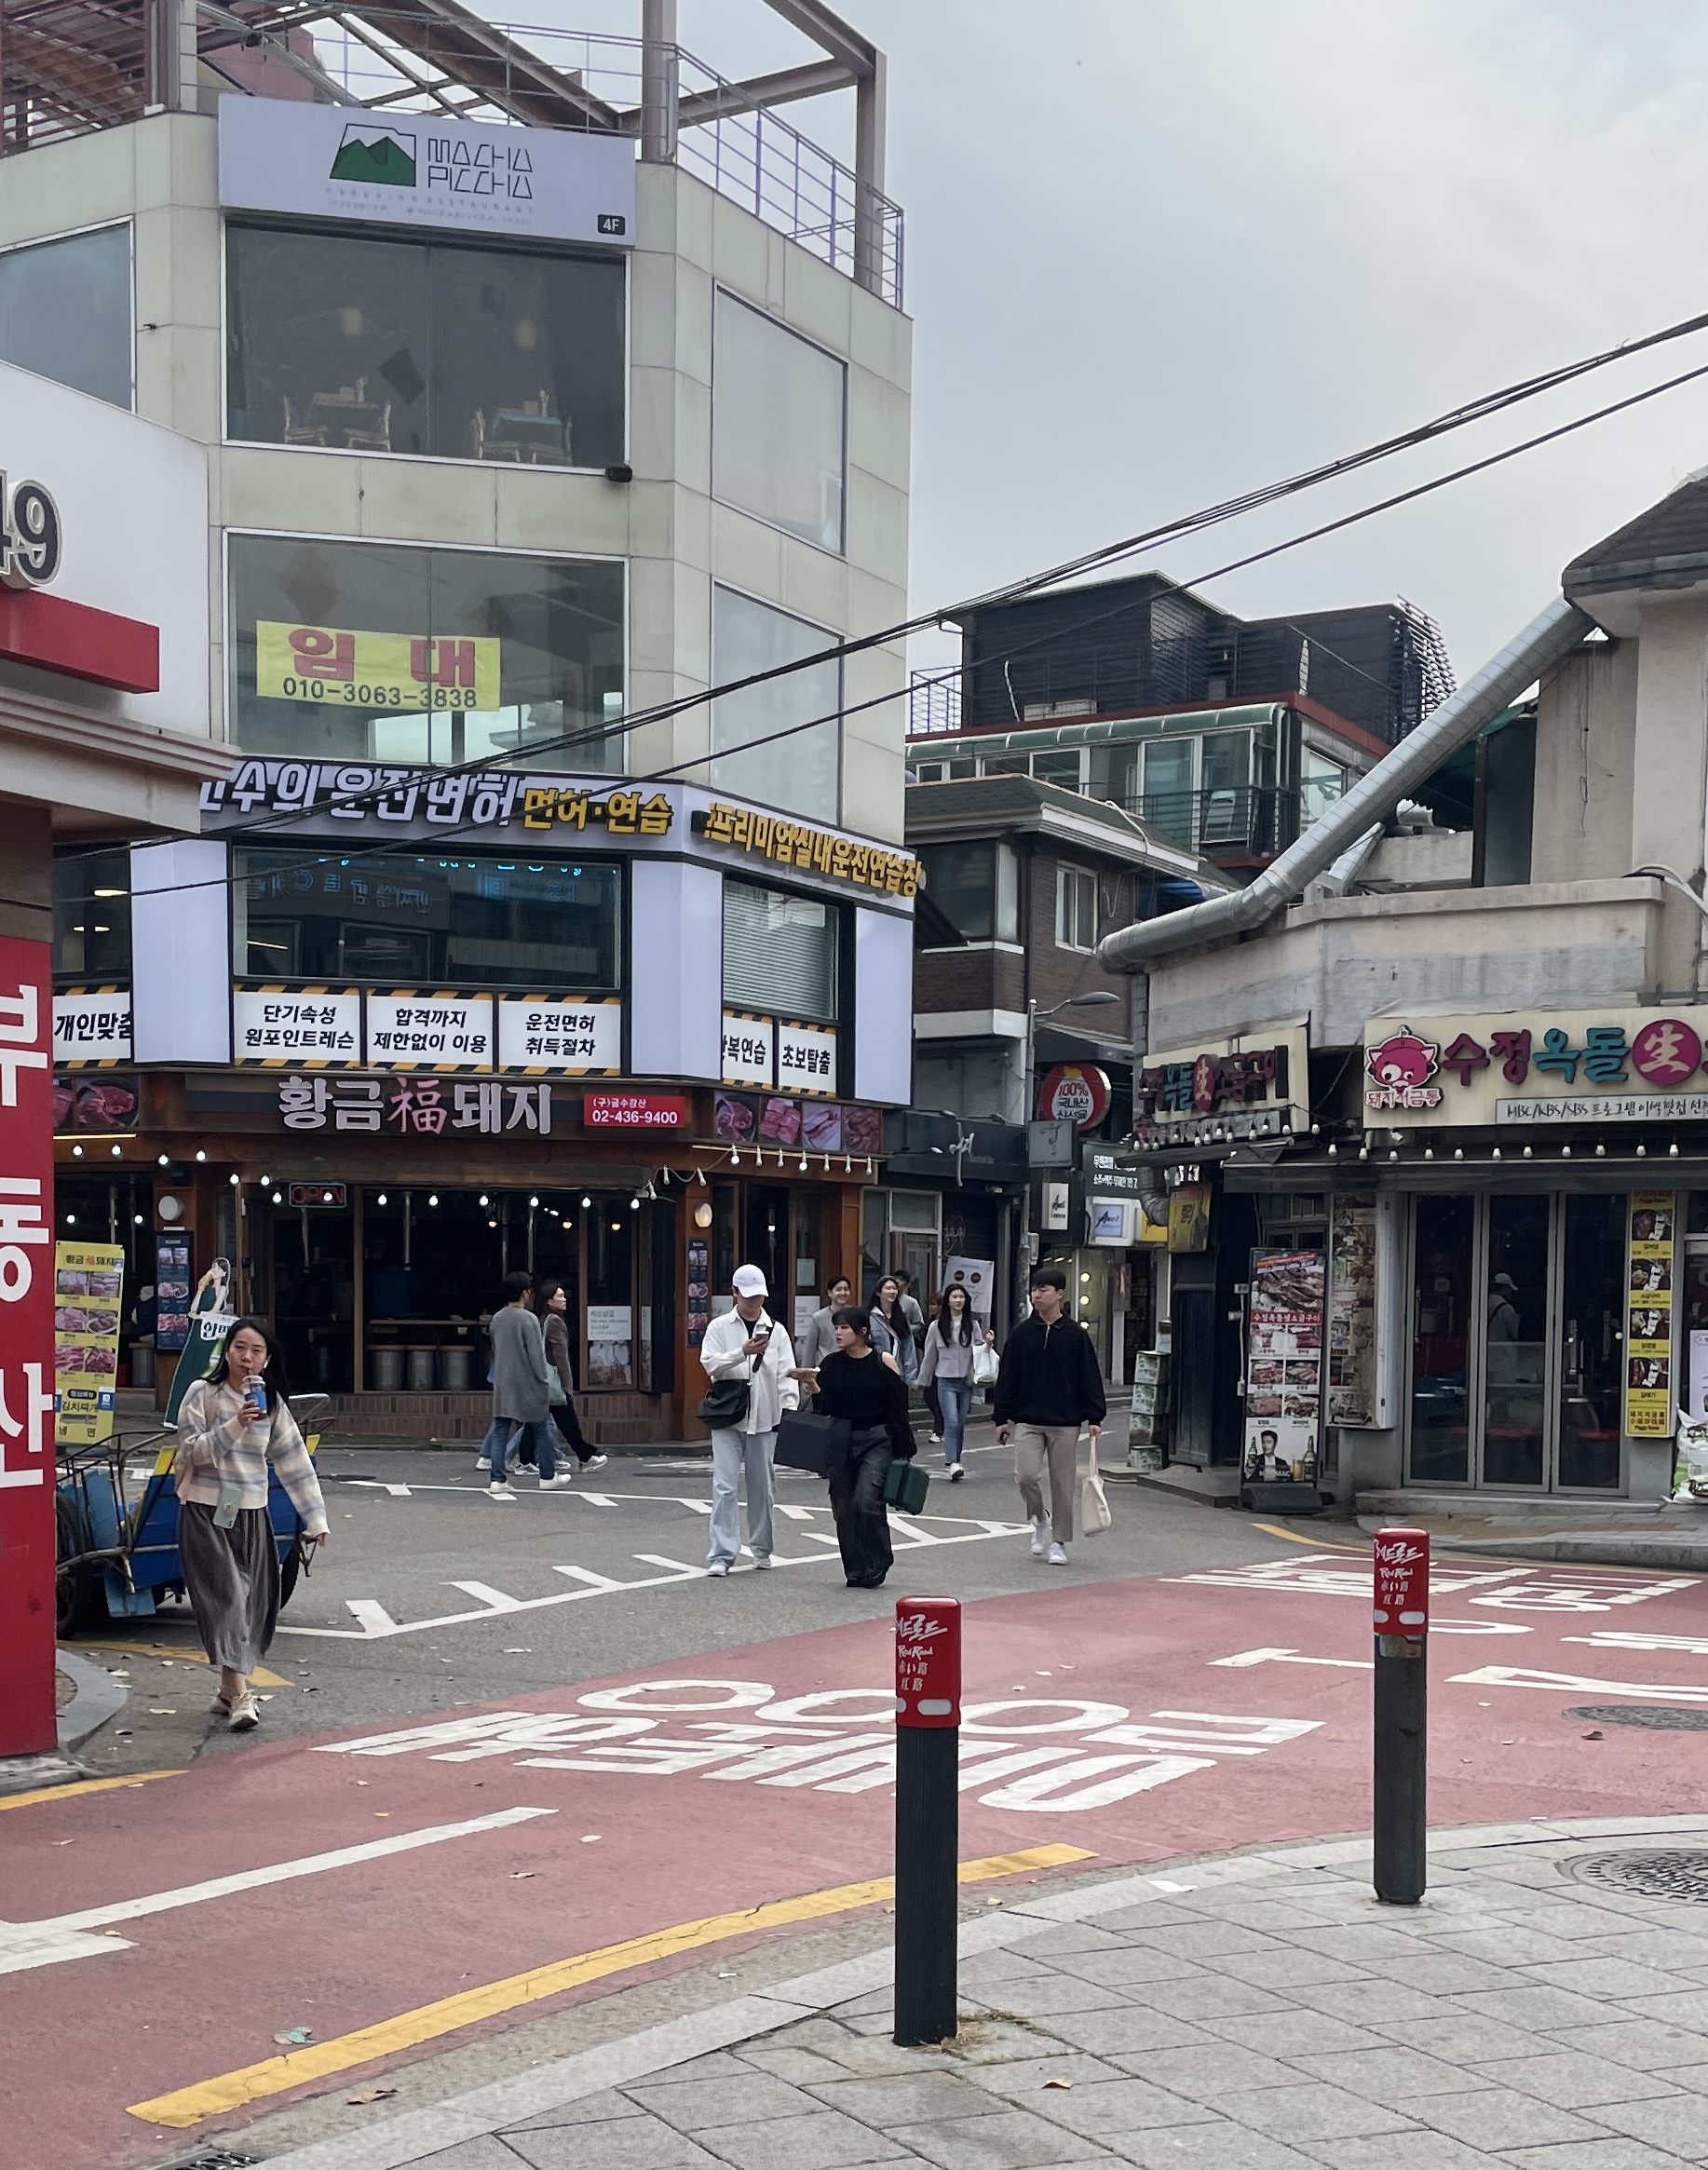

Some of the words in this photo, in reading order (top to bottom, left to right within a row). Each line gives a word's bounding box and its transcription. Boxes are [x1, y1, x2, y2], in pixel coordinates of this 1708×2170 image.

[602, 218, 621, 233] 4F
[0, 473, 62, 589] 9
[282, 677, 477, 709] 010-3063-3838
[264, 1005, 336, 1025] 단기속성
[396, 1009, 467, 1029] 합격까지
[525, 1013, 596, 1033] 운전면허
[245, 1028, 355, 1050] 원포인트레슨
[373, 1032, 446, 1051] 제한없이
[453, 1035, 487, 1054] 이용
[525, 1038, 596, 1057] 취득절차
[781, 1044, 831, 1075] 초보탈출
[1059, 1082, 1089, 1097] 100%
[591, 1110, 678, 1125] 02-436-9400
